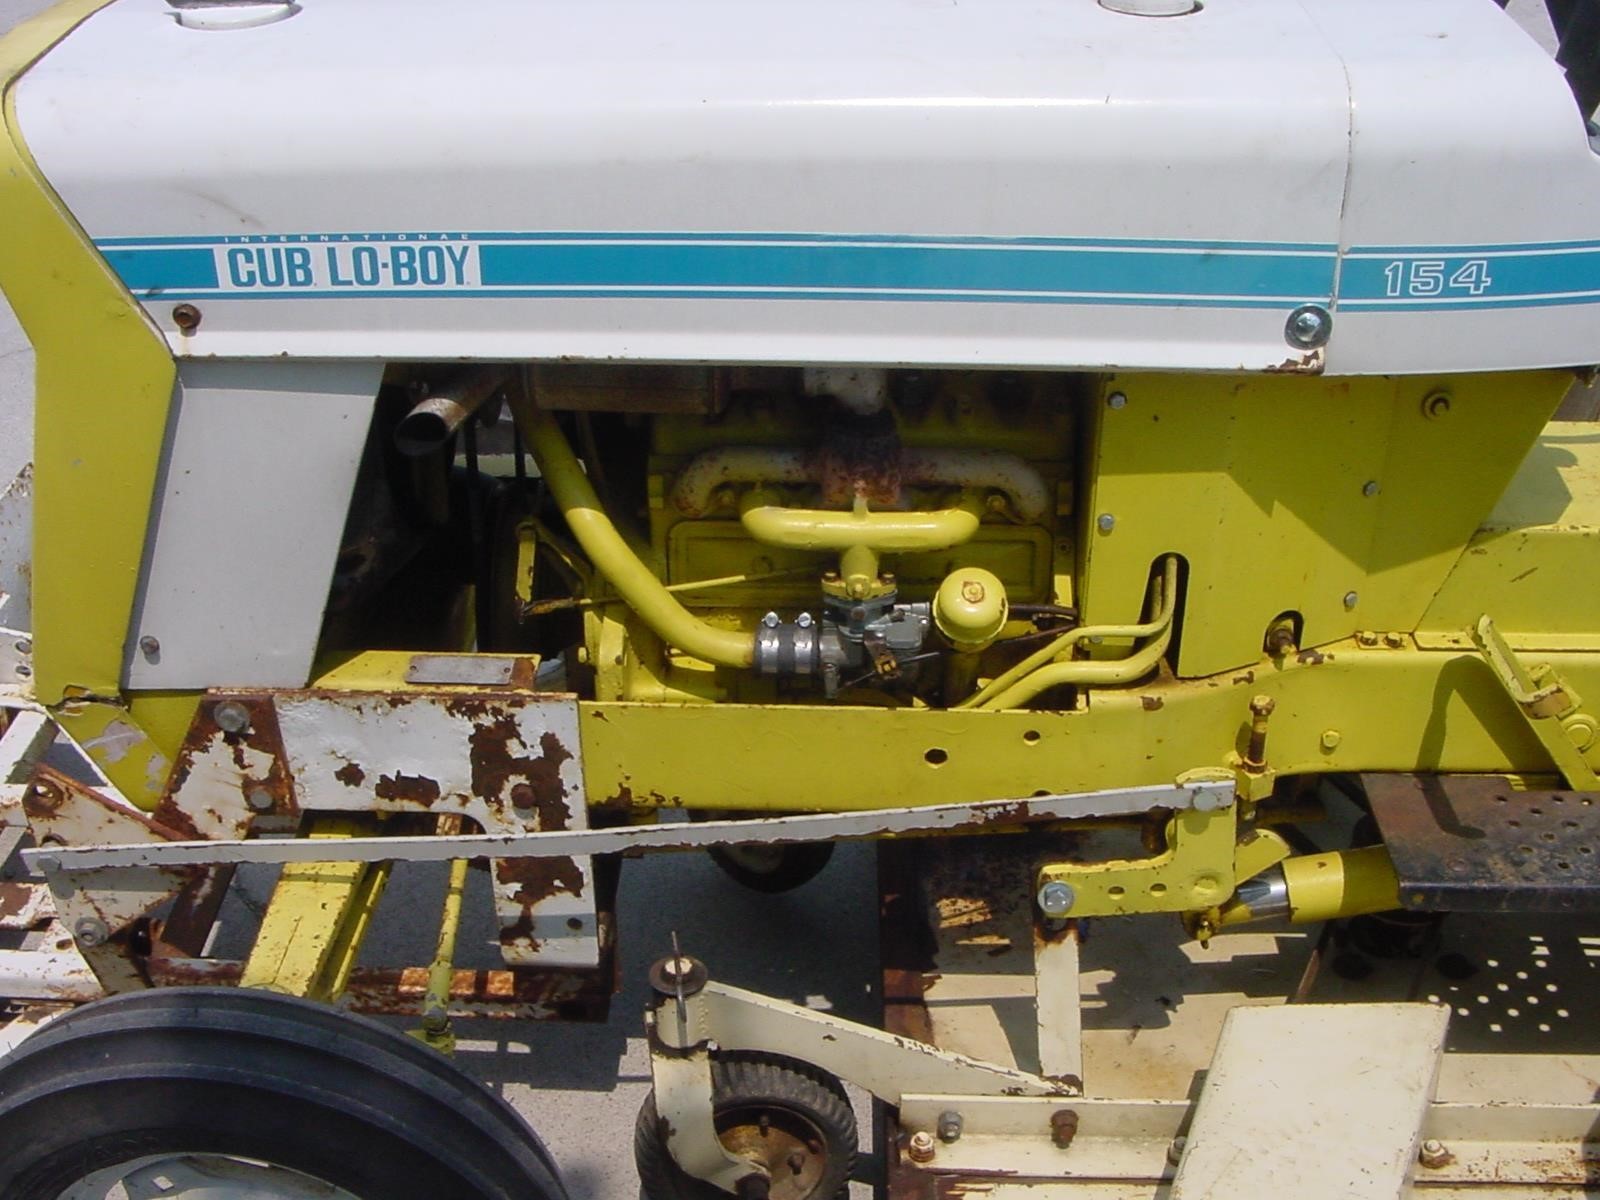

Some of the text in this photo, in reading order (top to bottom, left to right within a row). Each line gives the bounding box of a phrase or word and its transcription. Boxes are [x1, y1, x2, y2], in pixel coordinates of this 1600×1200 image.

[227, 245, 470, 287] CUB LO-BOY
[1384, 260, 1492, 296] 154
